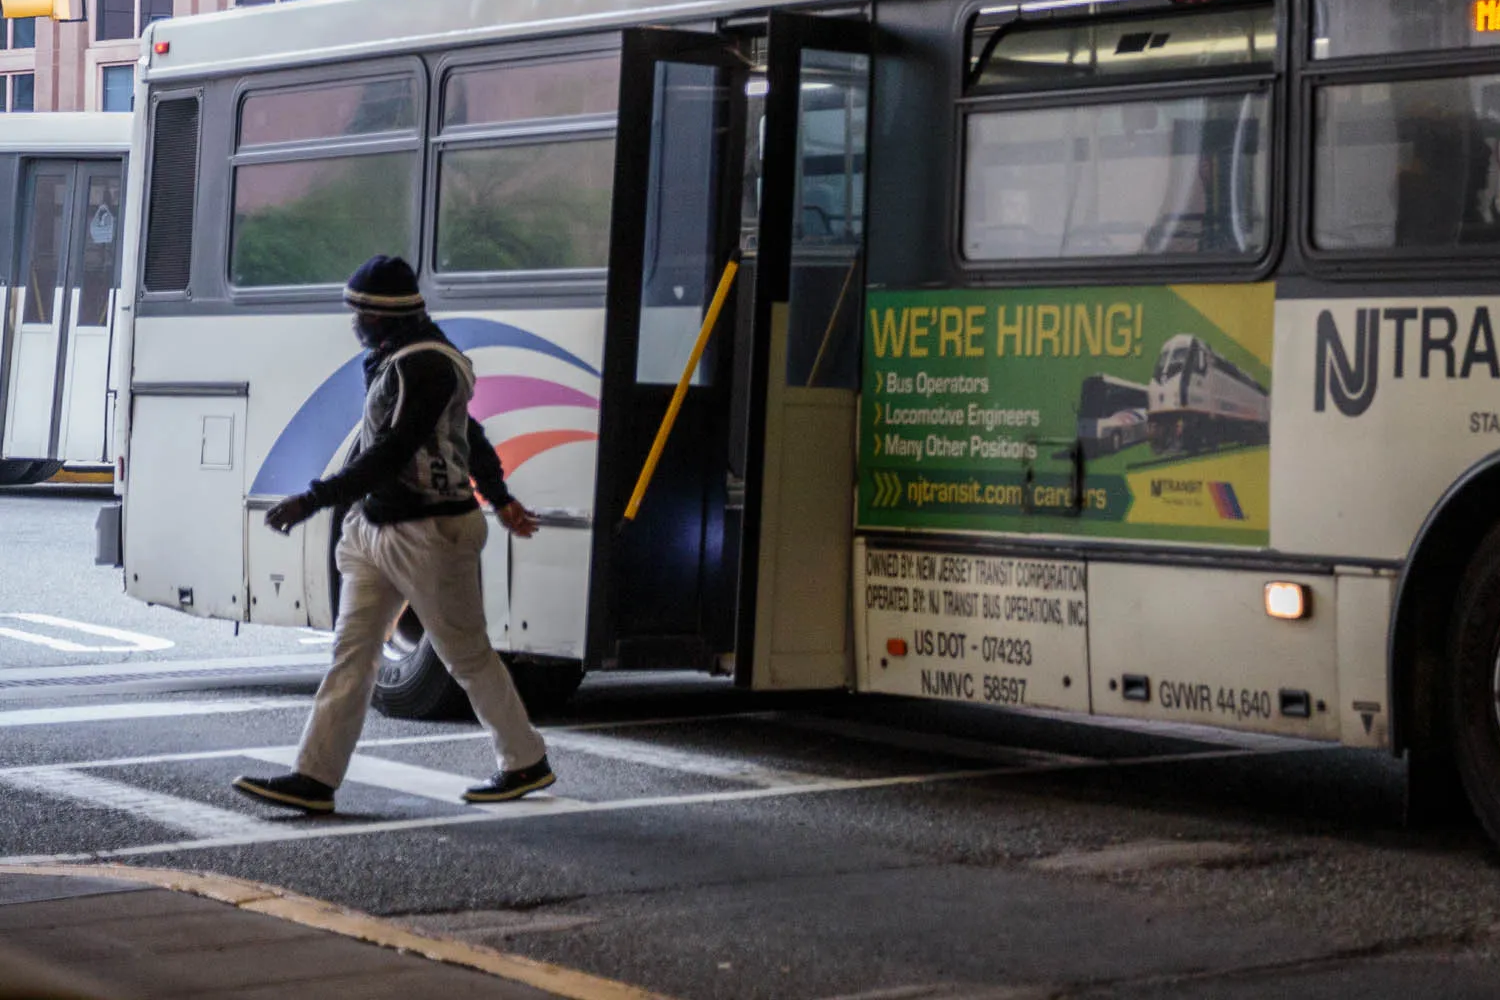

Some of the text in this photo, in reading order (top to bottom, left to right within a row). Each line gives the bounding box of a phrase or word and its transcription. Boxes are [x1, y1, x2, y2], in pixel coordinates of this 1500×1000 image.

[870, 303, 1143, 359] WE'RE HIRING!
[886, 371, 990, 398] Bus Operators
[885, 403, 1040, 431] Locomotive Engineers
[885, 434, 1038, 462] Many Other Positions
[866, 552, 1086, 592] OWNED BY: NEW JERSEY TRANSIT CORPORATION
[866, 584, 909, 613] OPERATED
[928, 589, 940, 615] NJ
[943, 590, 979, 618] TRANSIT
[982, 593, 1001, 620] BUS
[1004, 595, 1064, 625] OPERATIONS,
[1067, 599, 1088, 627] INC.
[914, 629, 934, 656] US
[937, 631, 966, 658] DOT
[982, 636, 1033, 666] 074293
[921, 669, 1027, 703] NJMVC 58597
[1159, 680, 1271, 721] GVWR 44,640
